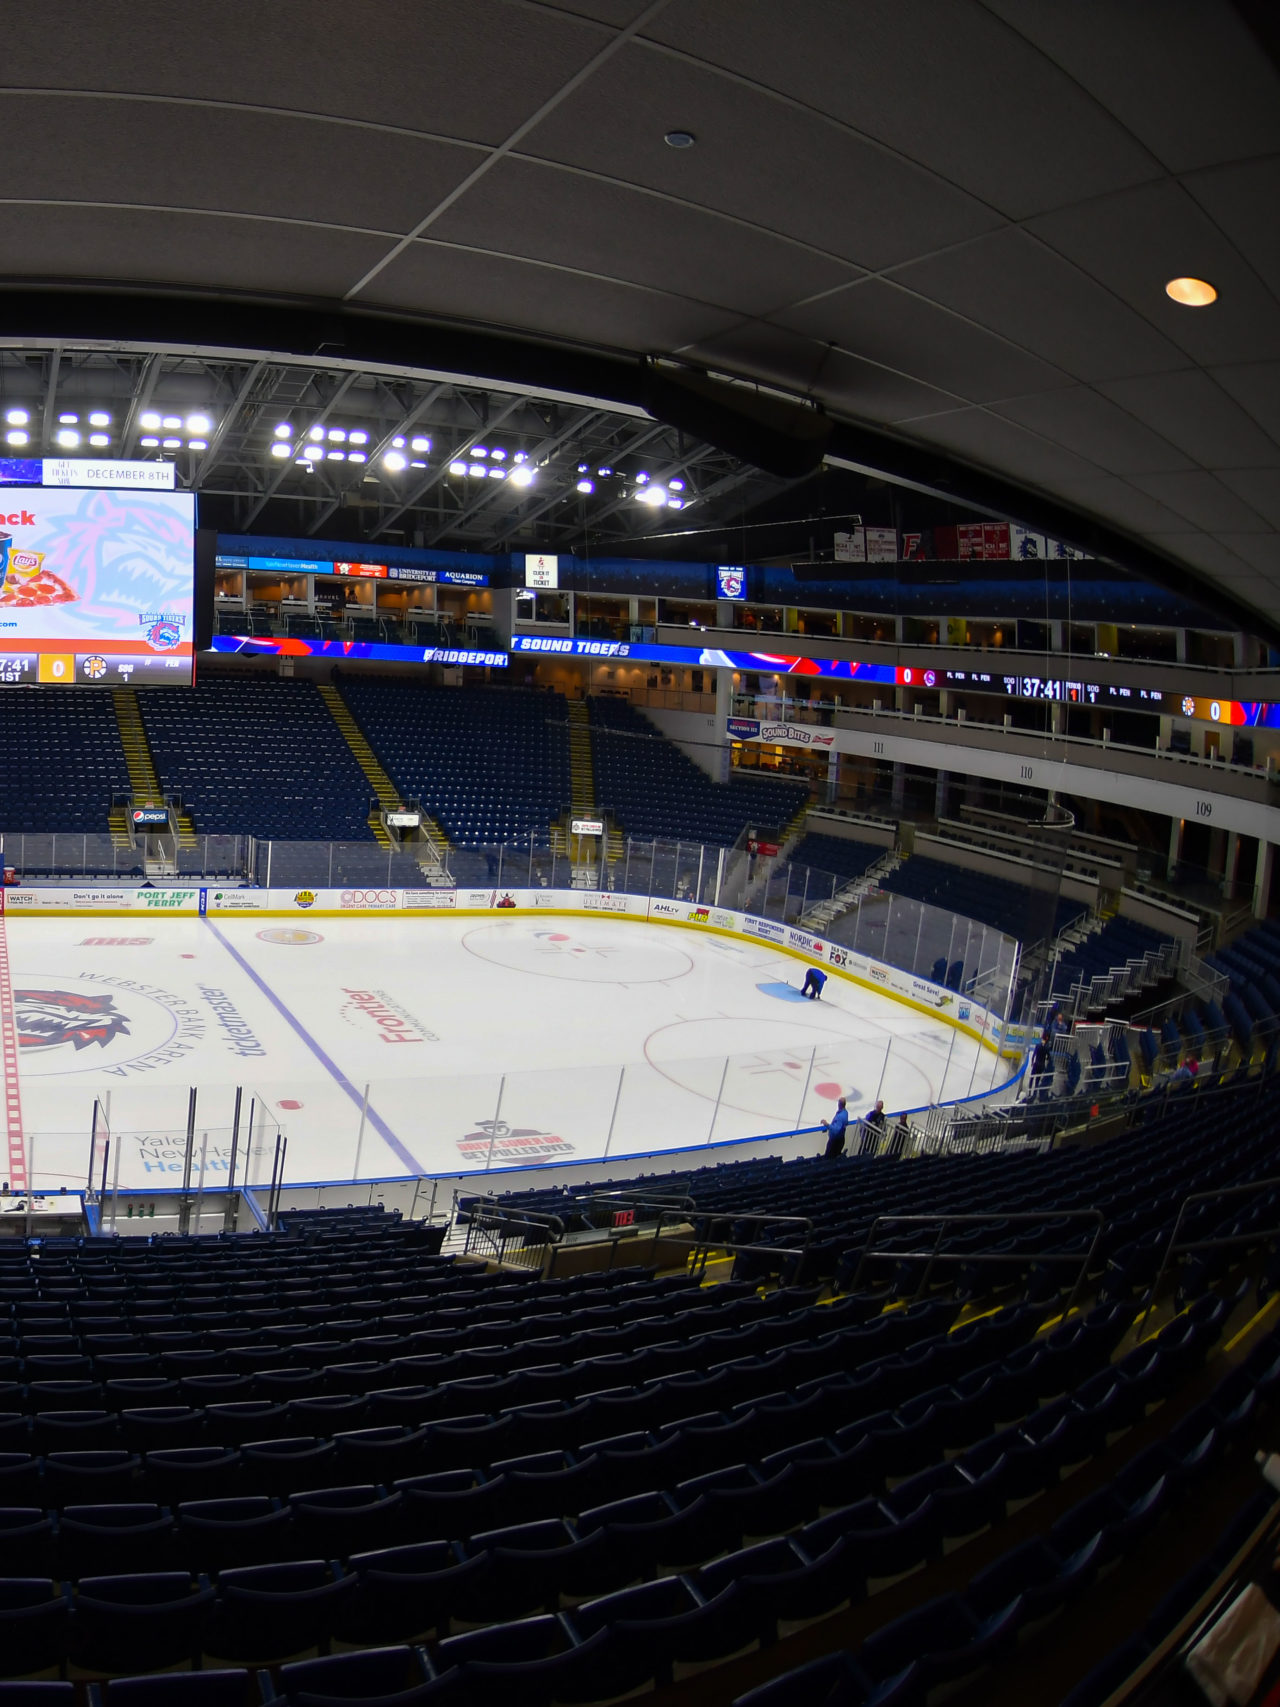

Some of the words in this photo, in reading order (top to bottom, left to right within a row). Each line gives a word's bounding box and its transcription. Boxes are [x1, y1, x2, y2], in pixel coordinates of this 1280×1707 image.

[87, 469, 145, 480] DECEMBER
[148, 471, 169, 481] 8TH
[445, 571, 483, 580] AQUARION
[521, 638, 572, 652] SOUND
[577, 641, 630, 656] TIGERS
[52, 660, 65, 677] 0
[904, 668, 912, 683] 0
[0, 672, 21, 682] 1ST
[123, 674, 129, 682] 1
[1007, 684, 1012, 694] 1
[1023, 678, 1061, 700] 37:41
[1071, 689, 1077, 701] 1
[1087, 685, 1099, 693] SOG
[1090, 693, 1095, 703] 1
[1210, 701, 1220, 721] 0
[762, 727, 787, 739] SOUND
[788, 727, 811, 743] BITES
[874, 742, 884, 754] 111
[1020, 766, 1033, 780] 110
[1195, 801, 1212, 817] 109
[144, 813, 166, 821] pepsi
[353, 890, 397, 903] DOCS
[584, 899, 628, 908] ULTIMATE
[790, 931, 813, 948] NORDIC
[829, 952, 847, 967] FOX
[79, 971, 187, 1007] WEBSTER
[199, 985, 267, 1057] ticketmaster
[340, 988, 424, 1043] Frontier
[175, 1009, 207, 1040] BANK
[102, 1041, 195, 1077] ARENA
[134, 1136, 187, 1147] Yale
[456, 1140, 499, 1151] DRIVE
[501, 1137, 541, 1148] SOBER
[461, 1151, 487, 1160] GET
[489, 1146, 540, 1158] PULLED
[540, 1143, 576, 1153] OVER
[144, 1160, 239, 1174] Health
